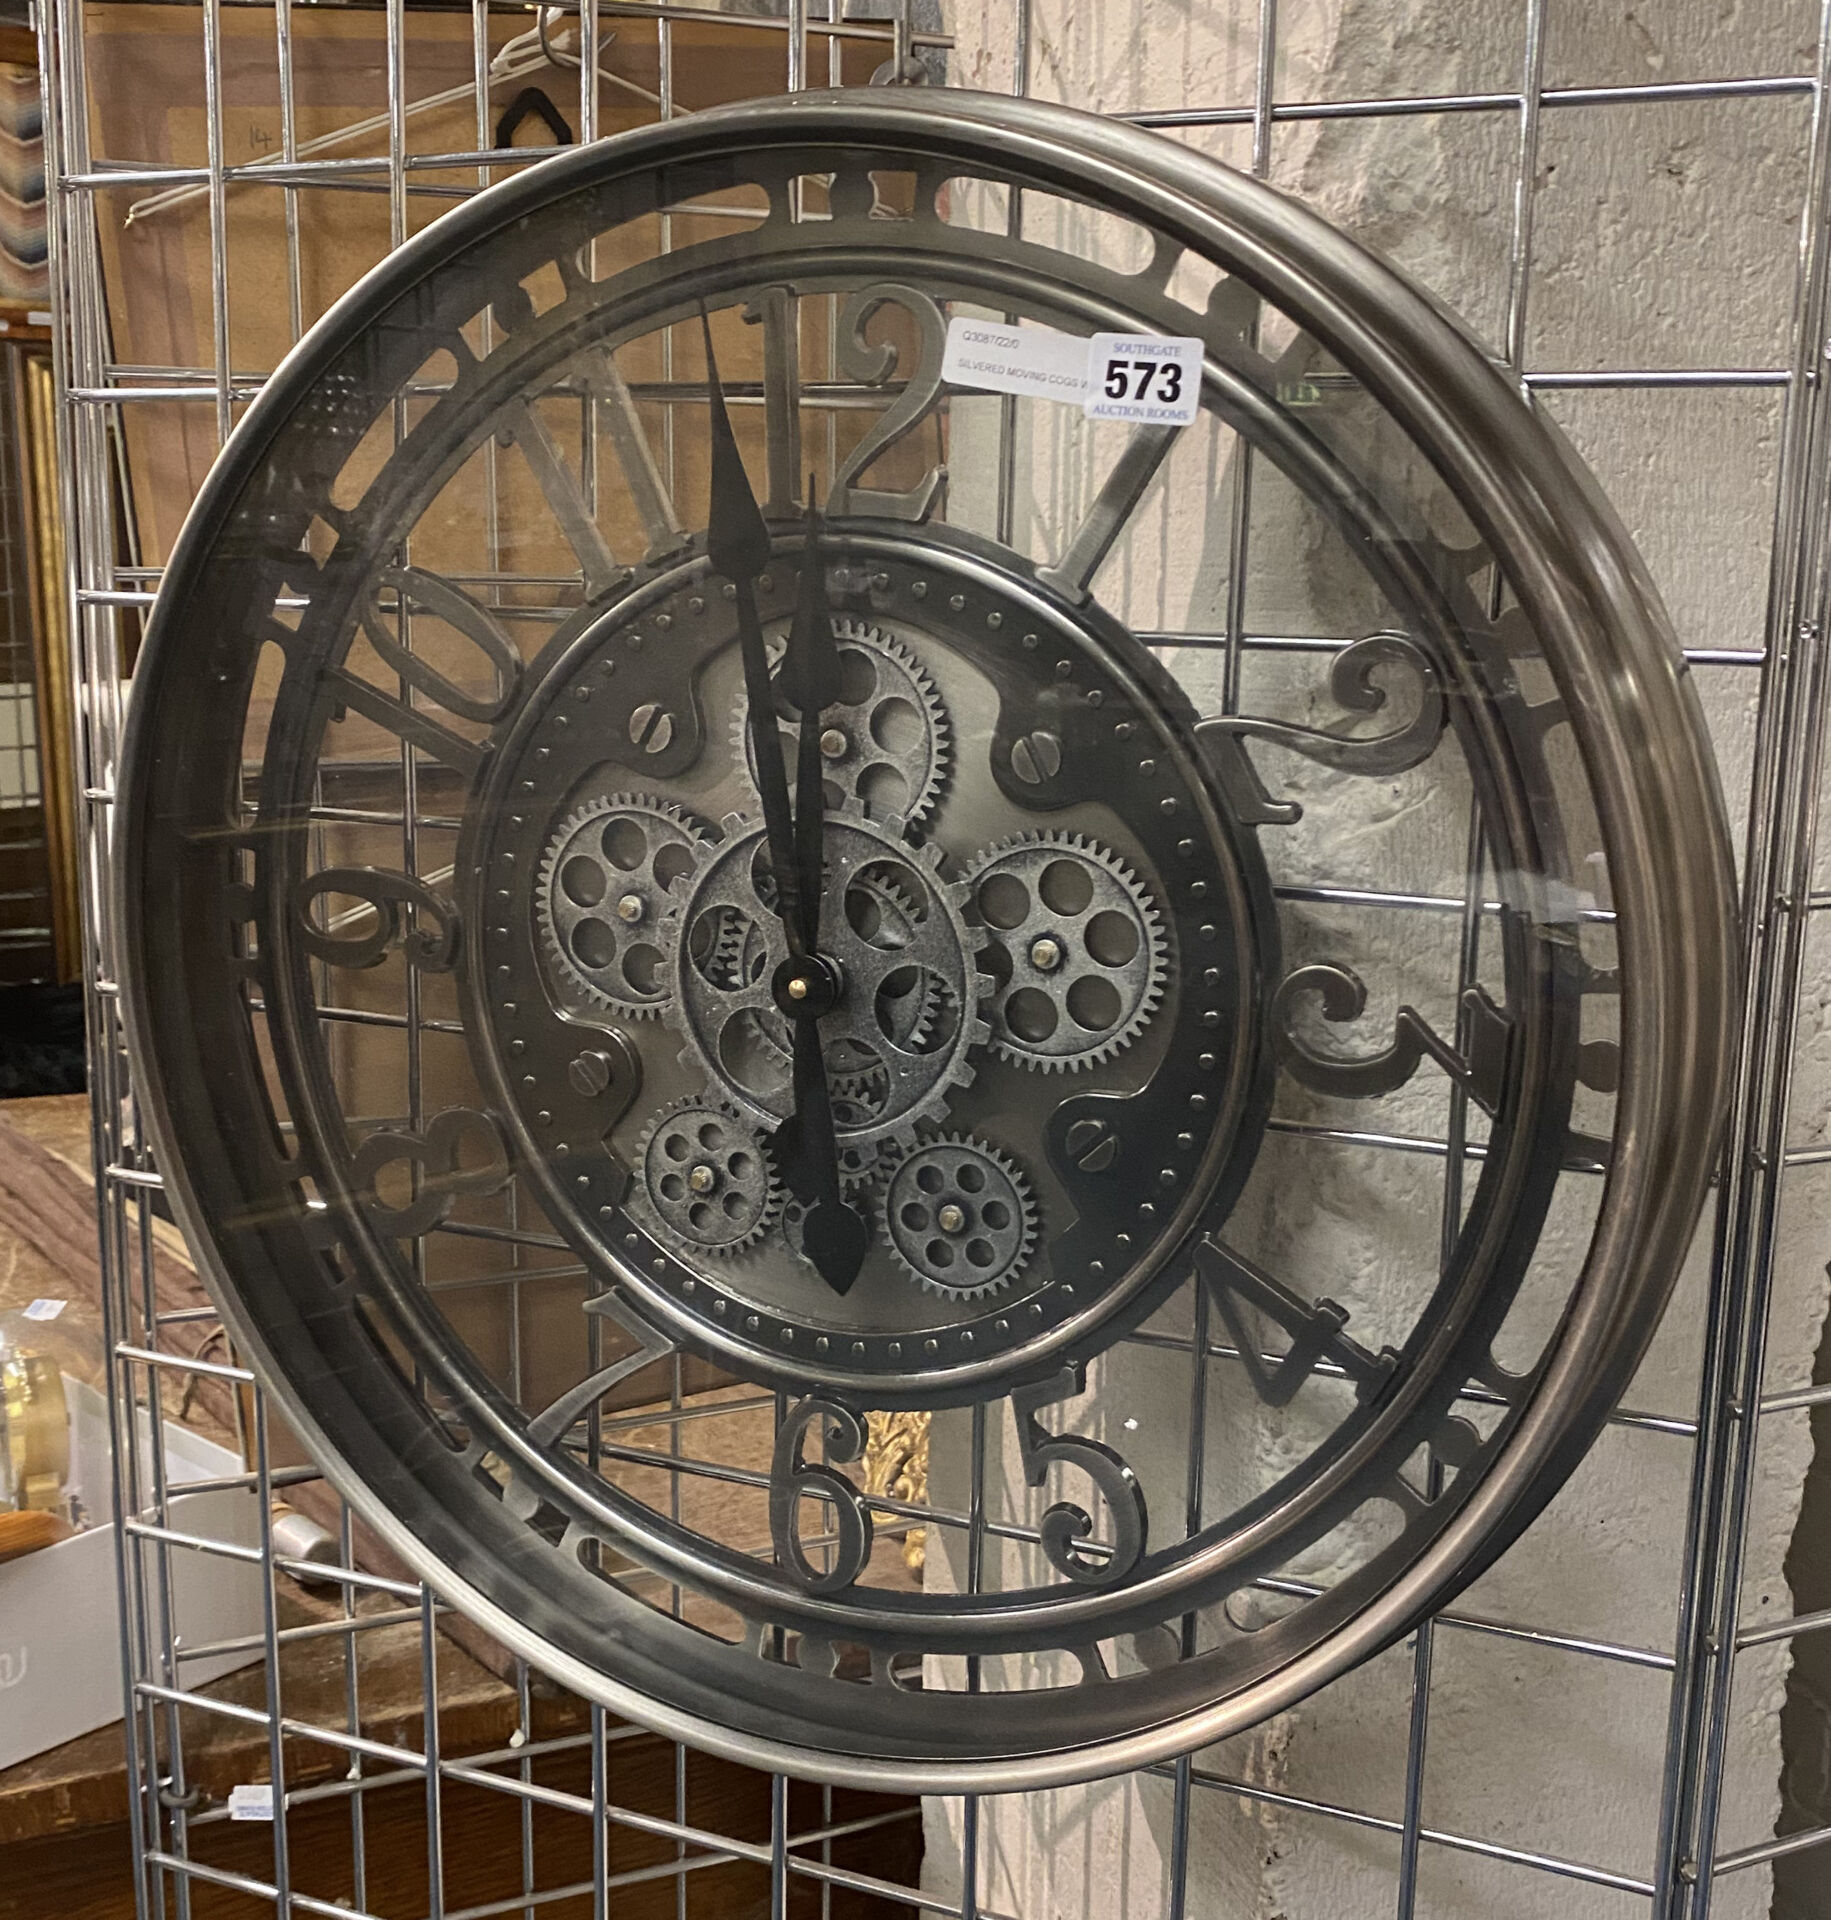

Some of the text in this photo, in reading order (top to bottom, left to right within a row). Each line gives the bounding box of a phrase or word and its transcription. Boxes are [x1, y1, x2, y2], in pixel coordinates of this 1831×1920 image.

[742, 283, 948, 522] 12
[958, 358, 1005, 374] SILVERED
[1007, 366, 1047, 382] MOVING
[1049, 373, 1079, 388] COGS
[1093, 404, 1189, 420] AUCTION ROOMS
[1105, 359, 1182, 403] 573
[1113, 342, 1182, 357] SOUTHGATE
[1194, 633, 1452, 824] 2
[300, 865, 463, 973] 9
[1272, 964, 1513, 1117] 3
[350, 1107, 515, 1238] 8
[526, 1286, 685, 1448] 7
[1192, 1230, 1401, 1405] 4
[769, 1393, 874, 1592] 6
[1011, 1358, 1148, 1585] 5
